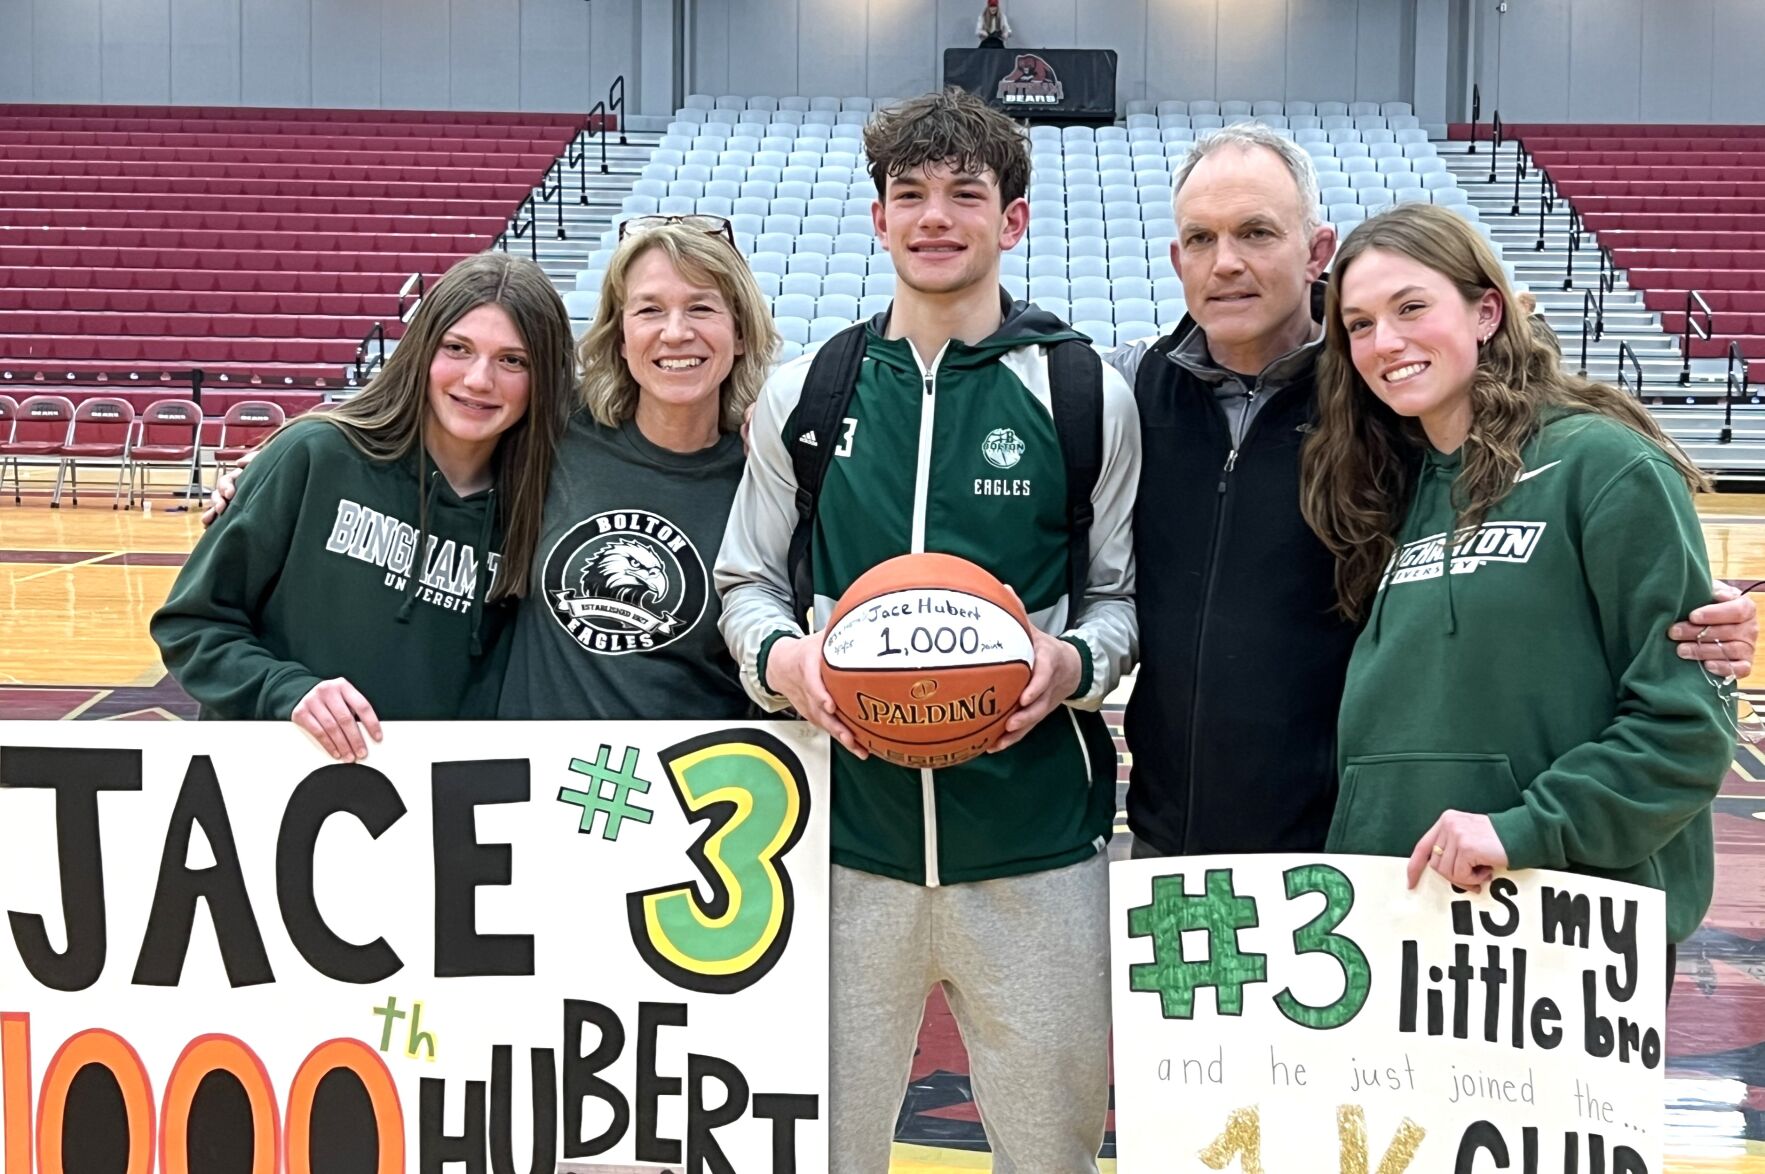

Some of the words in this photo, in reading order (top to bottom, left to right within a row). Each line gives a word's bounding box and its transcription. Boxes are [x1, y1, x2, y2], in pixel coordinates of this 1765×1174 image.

[974, 479, 1031, 496] EAGLES
[596, 513, 687, 553] BOLTON
[567, 618, 654, 651] EAGLES
[868, 601, 913, 623] Jace
[918, 597, 981, 621] Hubert
[877, 625, 980, 657] 1,000
[856, 686, 999, 726] SPALDING
[0, 745, 535, 991] JACE
[556, 727, 812, 995] #3
[1127, 863, 1372, 1030] #3
[1450, 877, 1520, 938] is
[1541, 885, 1639, 1002] my
[1399, 939, 1563, 1050] little
[1581, 969, 1661, 1070] bro
[418, 998, 820, 1174] HUBERT
[1158, 1044, 1224, 1085] and
[1269, 1044, 1308, 1087] he
[1351, 1053, 1415, 1092] just
[1448, 1068, 1535, 1106] joined
